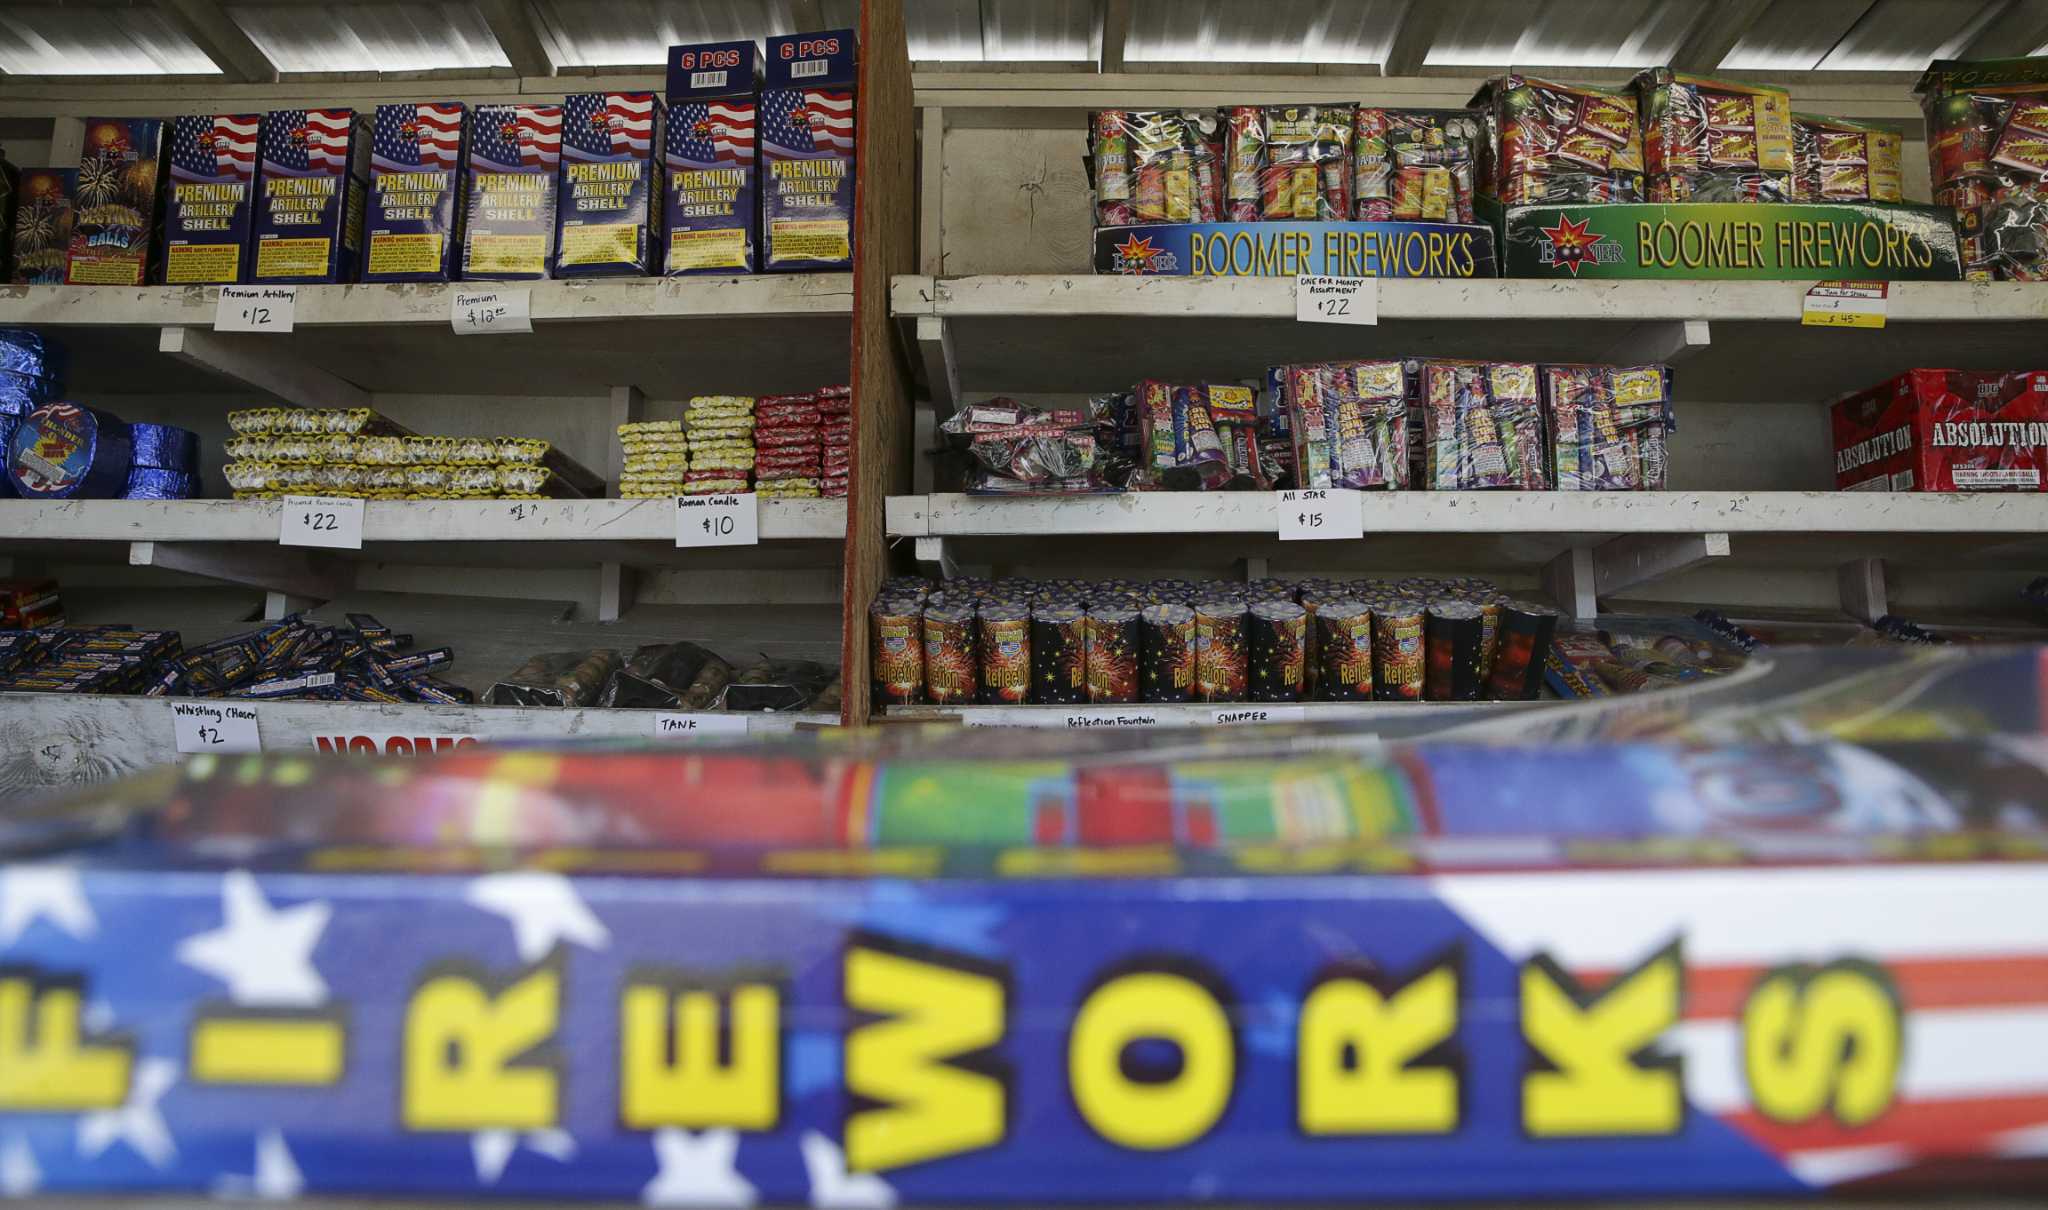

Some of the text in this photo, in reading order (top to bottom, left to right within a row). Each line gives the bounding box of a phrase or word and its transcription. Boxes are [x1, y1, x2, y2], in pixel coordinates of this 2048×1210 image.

[780, 39, 839, 59] 6 PCS
[681, 50, 740, 70] 6 PCS
[567, 161, 640, 183] PREMIUM
[770, 160, 846, 179] PREMIUM
[265, 177, 336, 197] PREMIUM
[376, 172, 448, 192] PREMIUM
[474, 173, 550, 192] PREMIUM
[672, 168, 746, 190] PREMIUM
[778, 179, 839, 194] ARTILLERY
[174, 183, 245, 202] PREMIUM
[572, 181, 633, 198] ARTILLERY
[678, 188, 738, 205] ARTILLERY
[269, 197, 327, 212] ARTILLERY
[380, 192, 439, 208] ARTILLERY
[480, 192, 540, 208] ARTILLERY
[577, 197, 627, 211] SHELL
[783, 195, 833, 207] SHELL
[178, 202, 237, 218] ARTILLERY
[272, 212, 321, 224] SHELL
[384, 207, 433, 220] SHELL
[486, 209, 536, 220] SHELL
[683, 204, 734, 217] SHELL
[183, 219, 230, 230] SHELL
[88, 231, 129, 248] BALLS
[1636, 219, 1933, 269] BOOMER FIREWORKS
[1191, 231, 1474, 277] BOOMER FIREWORKS
[1336, 279, 1363, 287] MONEY
[222, 287, 259, 299] Premium
[456, 294, 497, 306] Premium
[242, 308, 271, 325] $12
[1932, 422, 2048, 447] ABSOLUTION
[1837, 424, 1912, 473] ABSOLUTION
[678, 496, 739, 508] Roman Candle
[1302, 490, 1326, 500] STAR
[304, 512, 339, 530] $22
[702, 515, 734, 536] $10
[1298, 513, 1323, 527] $15
[174, 704, 222, 723] Whistling
[1067, 715, 1156, 728] Reflection Fountain
[1217, 711, 1268, 724] SNAPPER
[661, 718, 697, 732] TANK
[199, 724, 224, 744] $2
[0, 938, 1903, 1174] FIREWORKS
